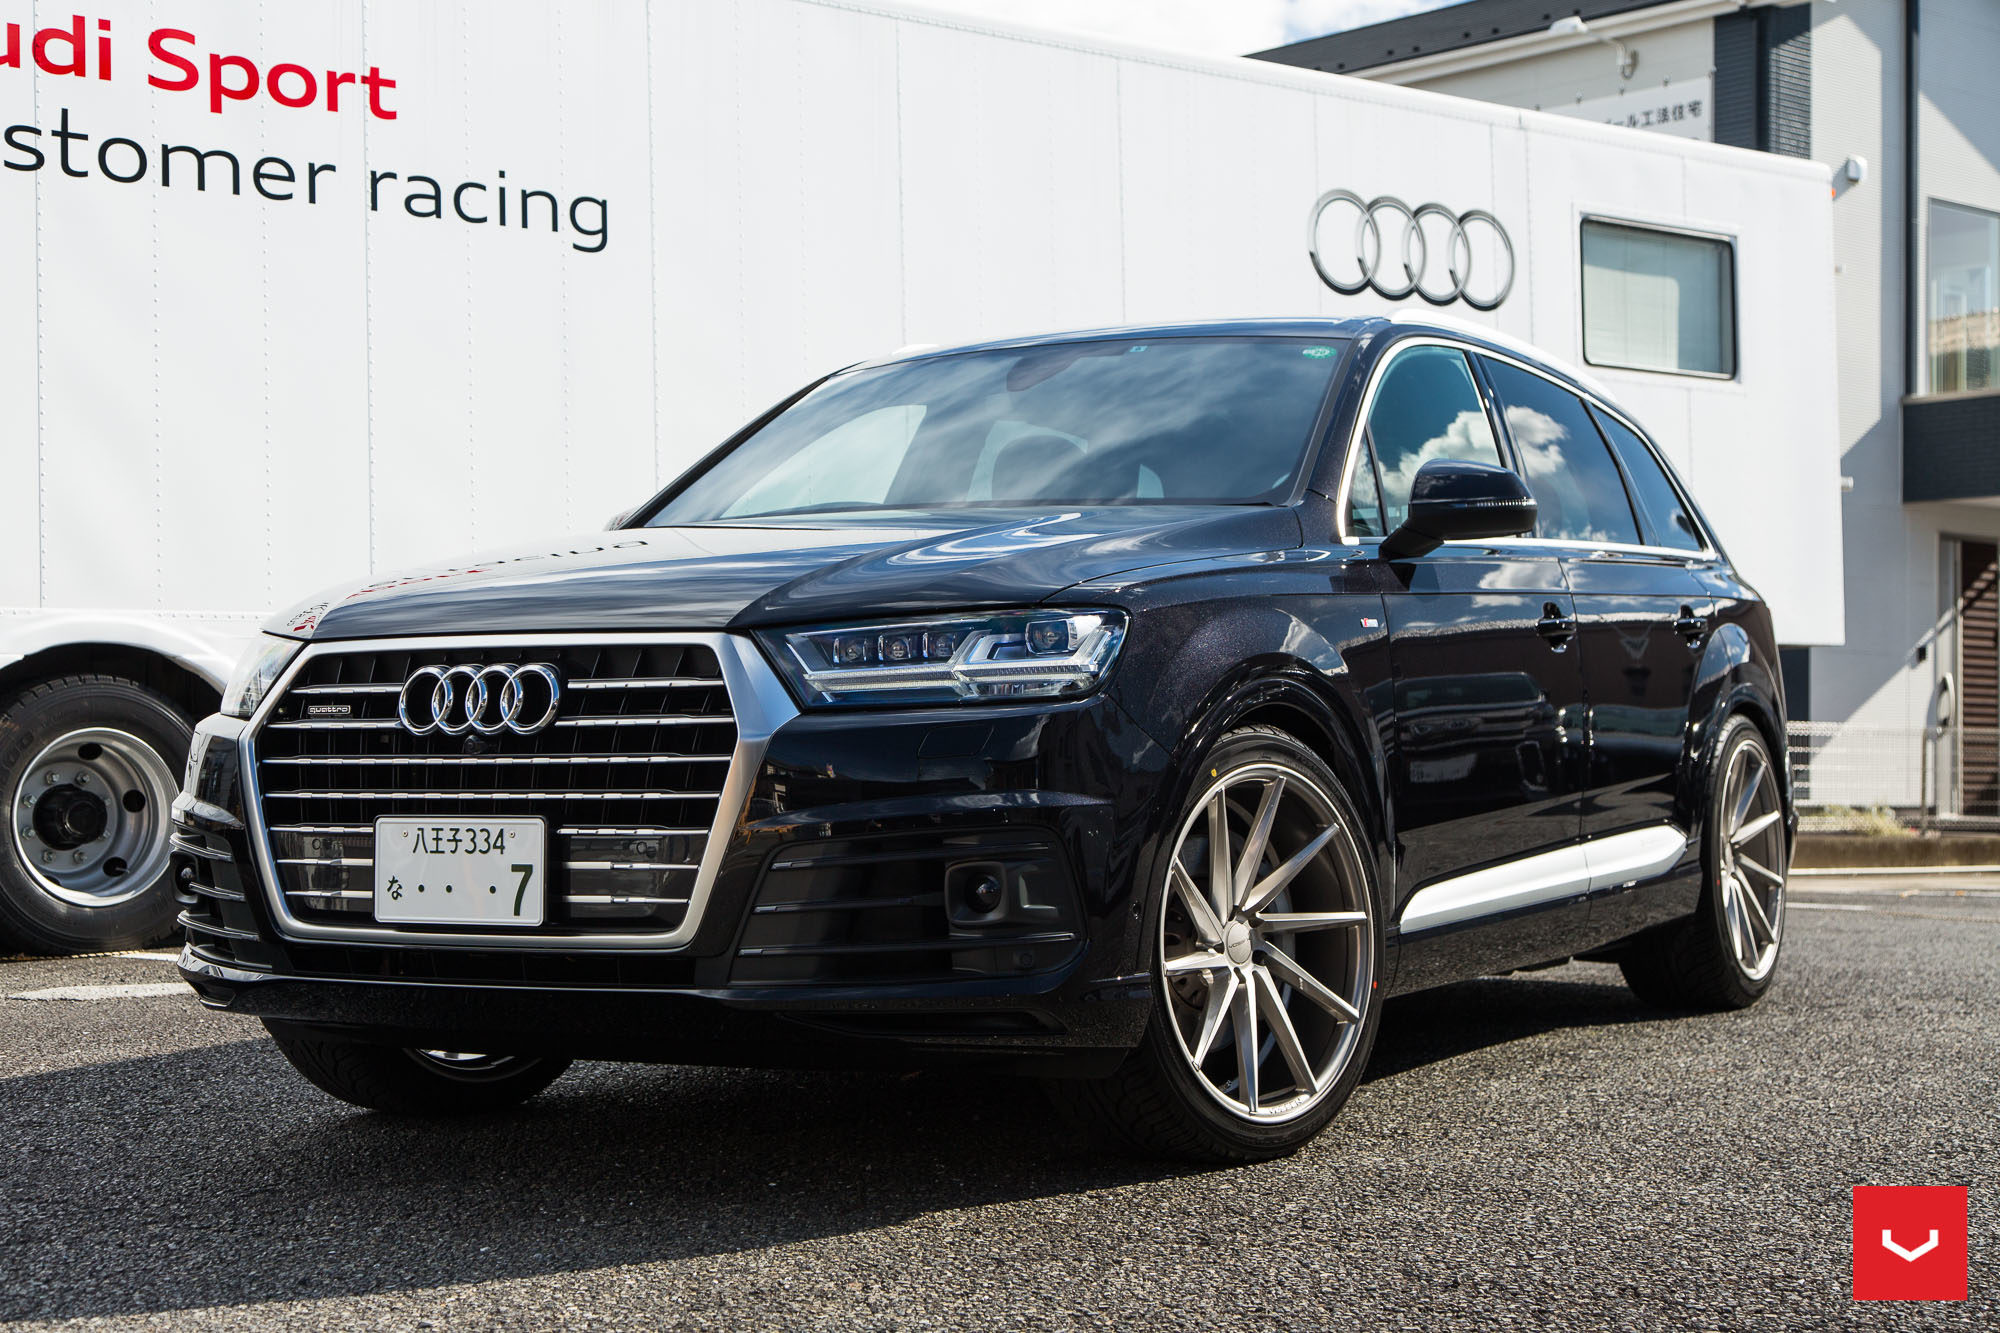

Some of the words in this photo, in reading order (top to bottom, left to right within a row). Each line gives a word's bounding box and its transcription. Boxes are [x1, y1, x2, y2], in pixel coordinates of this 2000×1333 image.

[148, 28, 397, 120] Sport
[3, 108, 336, 205] stomer
[370, 170, 608, 253] racing
[309, 706, 349, 714] quattro
[412, 827, 506, 855] 八王子334
